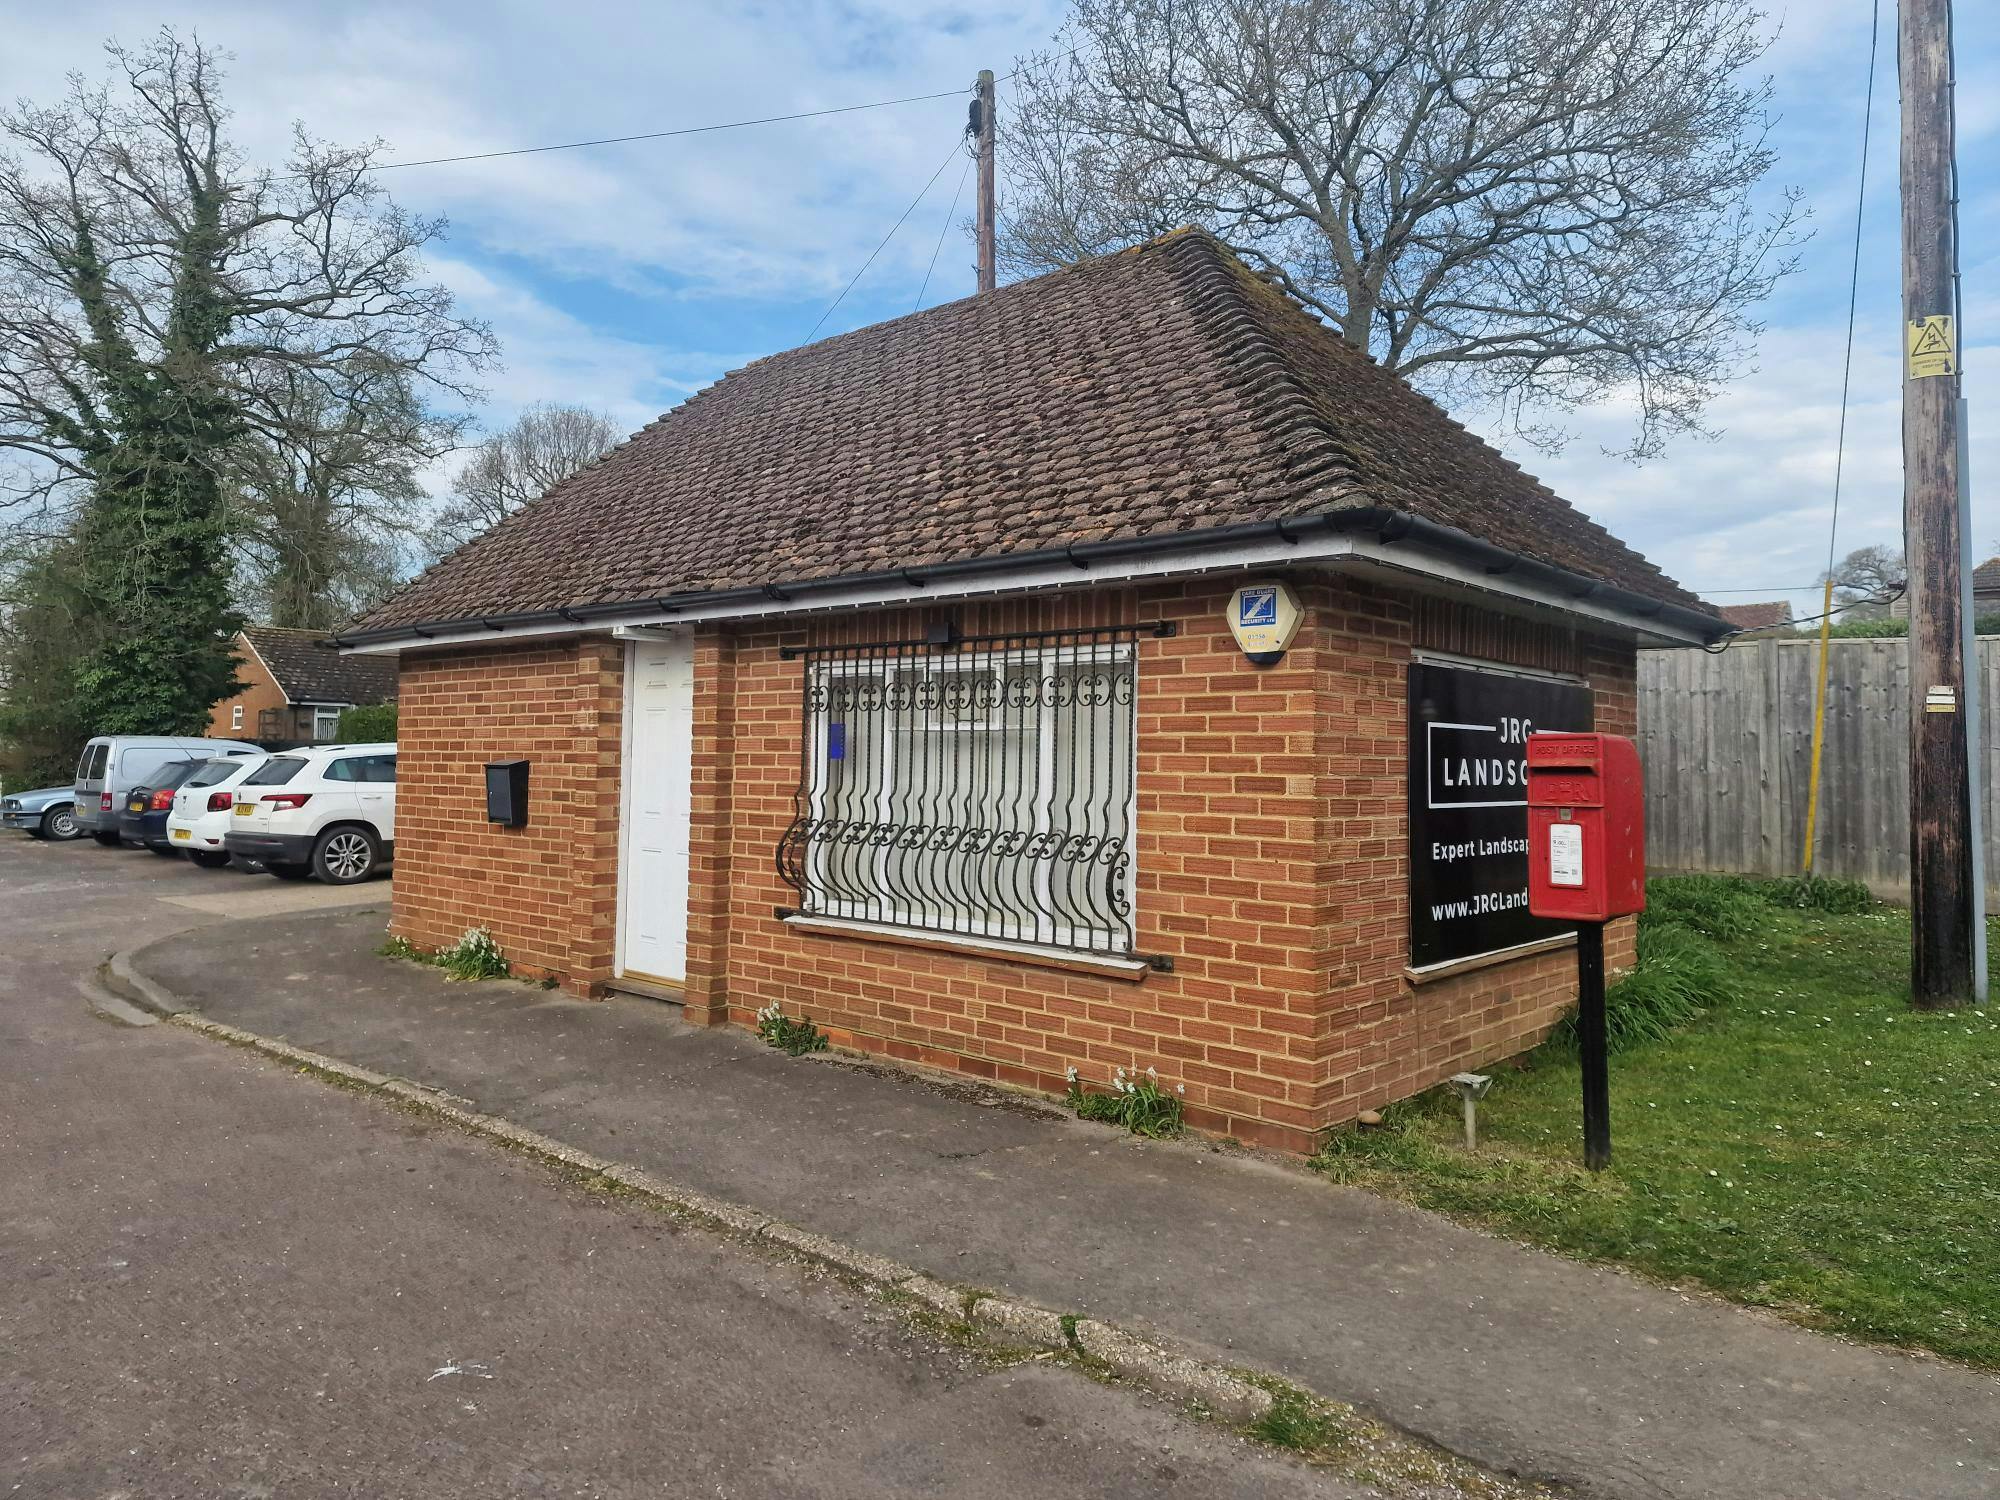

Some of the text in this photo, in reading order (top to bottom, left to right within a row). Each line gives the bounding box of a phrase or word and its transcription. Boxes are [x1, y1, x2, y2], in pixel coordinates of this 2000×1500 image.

[1500, 717, 1532, 744] JRG
[1536, 744, 1596, 755] POST OFFICE
[1444, 758, 1528, 786] LANDSC
[1432, 841, 1475, 863] Expert
